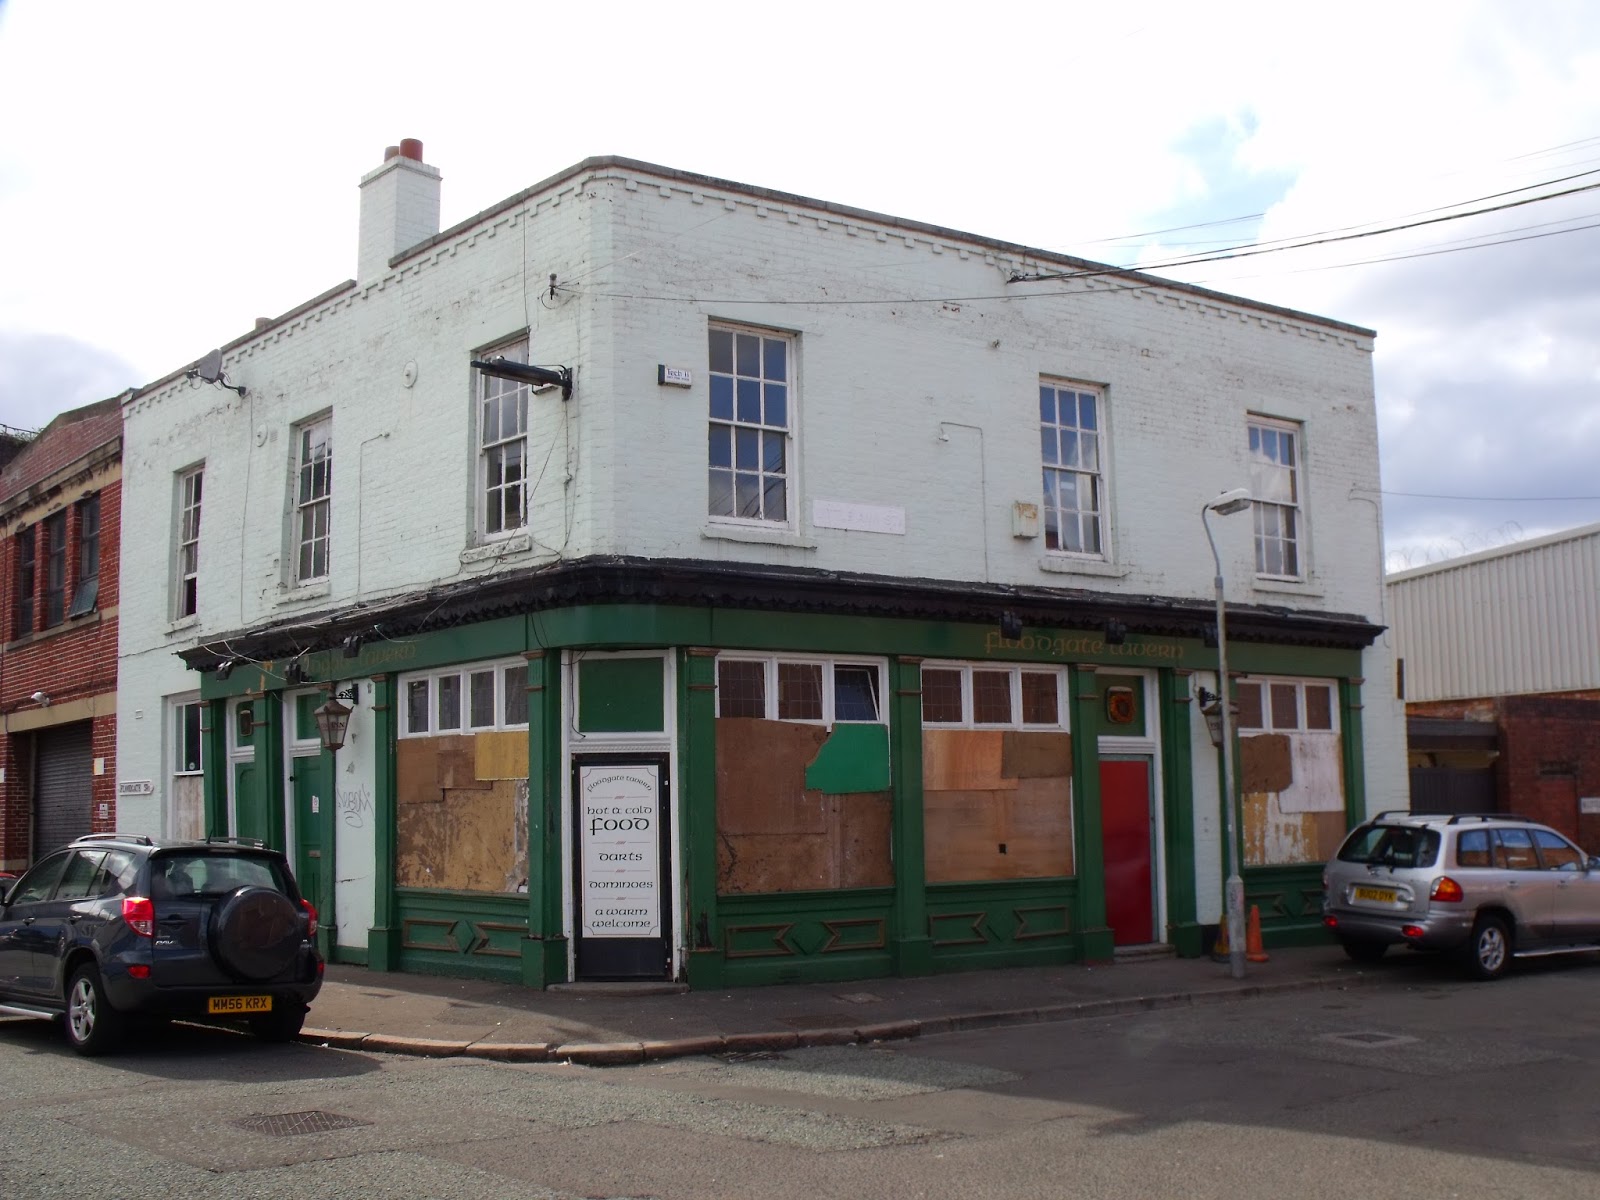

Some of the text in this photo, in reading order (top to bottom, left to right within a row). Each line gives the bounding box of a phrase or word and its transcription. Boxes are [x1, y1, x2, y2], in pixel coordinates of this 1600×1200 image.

[587, 775, 624, 793] floodgate
[587, 806, 609, 815] hot
[625, 805, 652, 815] cold
[590, 816, 650, 836] food
[599, 852, 643, 861] darts
[589, 881, 653, 889] dominoes
[595, 908, 648, 916] a warm
[592, 919, 651, 928] welcome
[213, 997, 267, 1010] MM56 KRX
